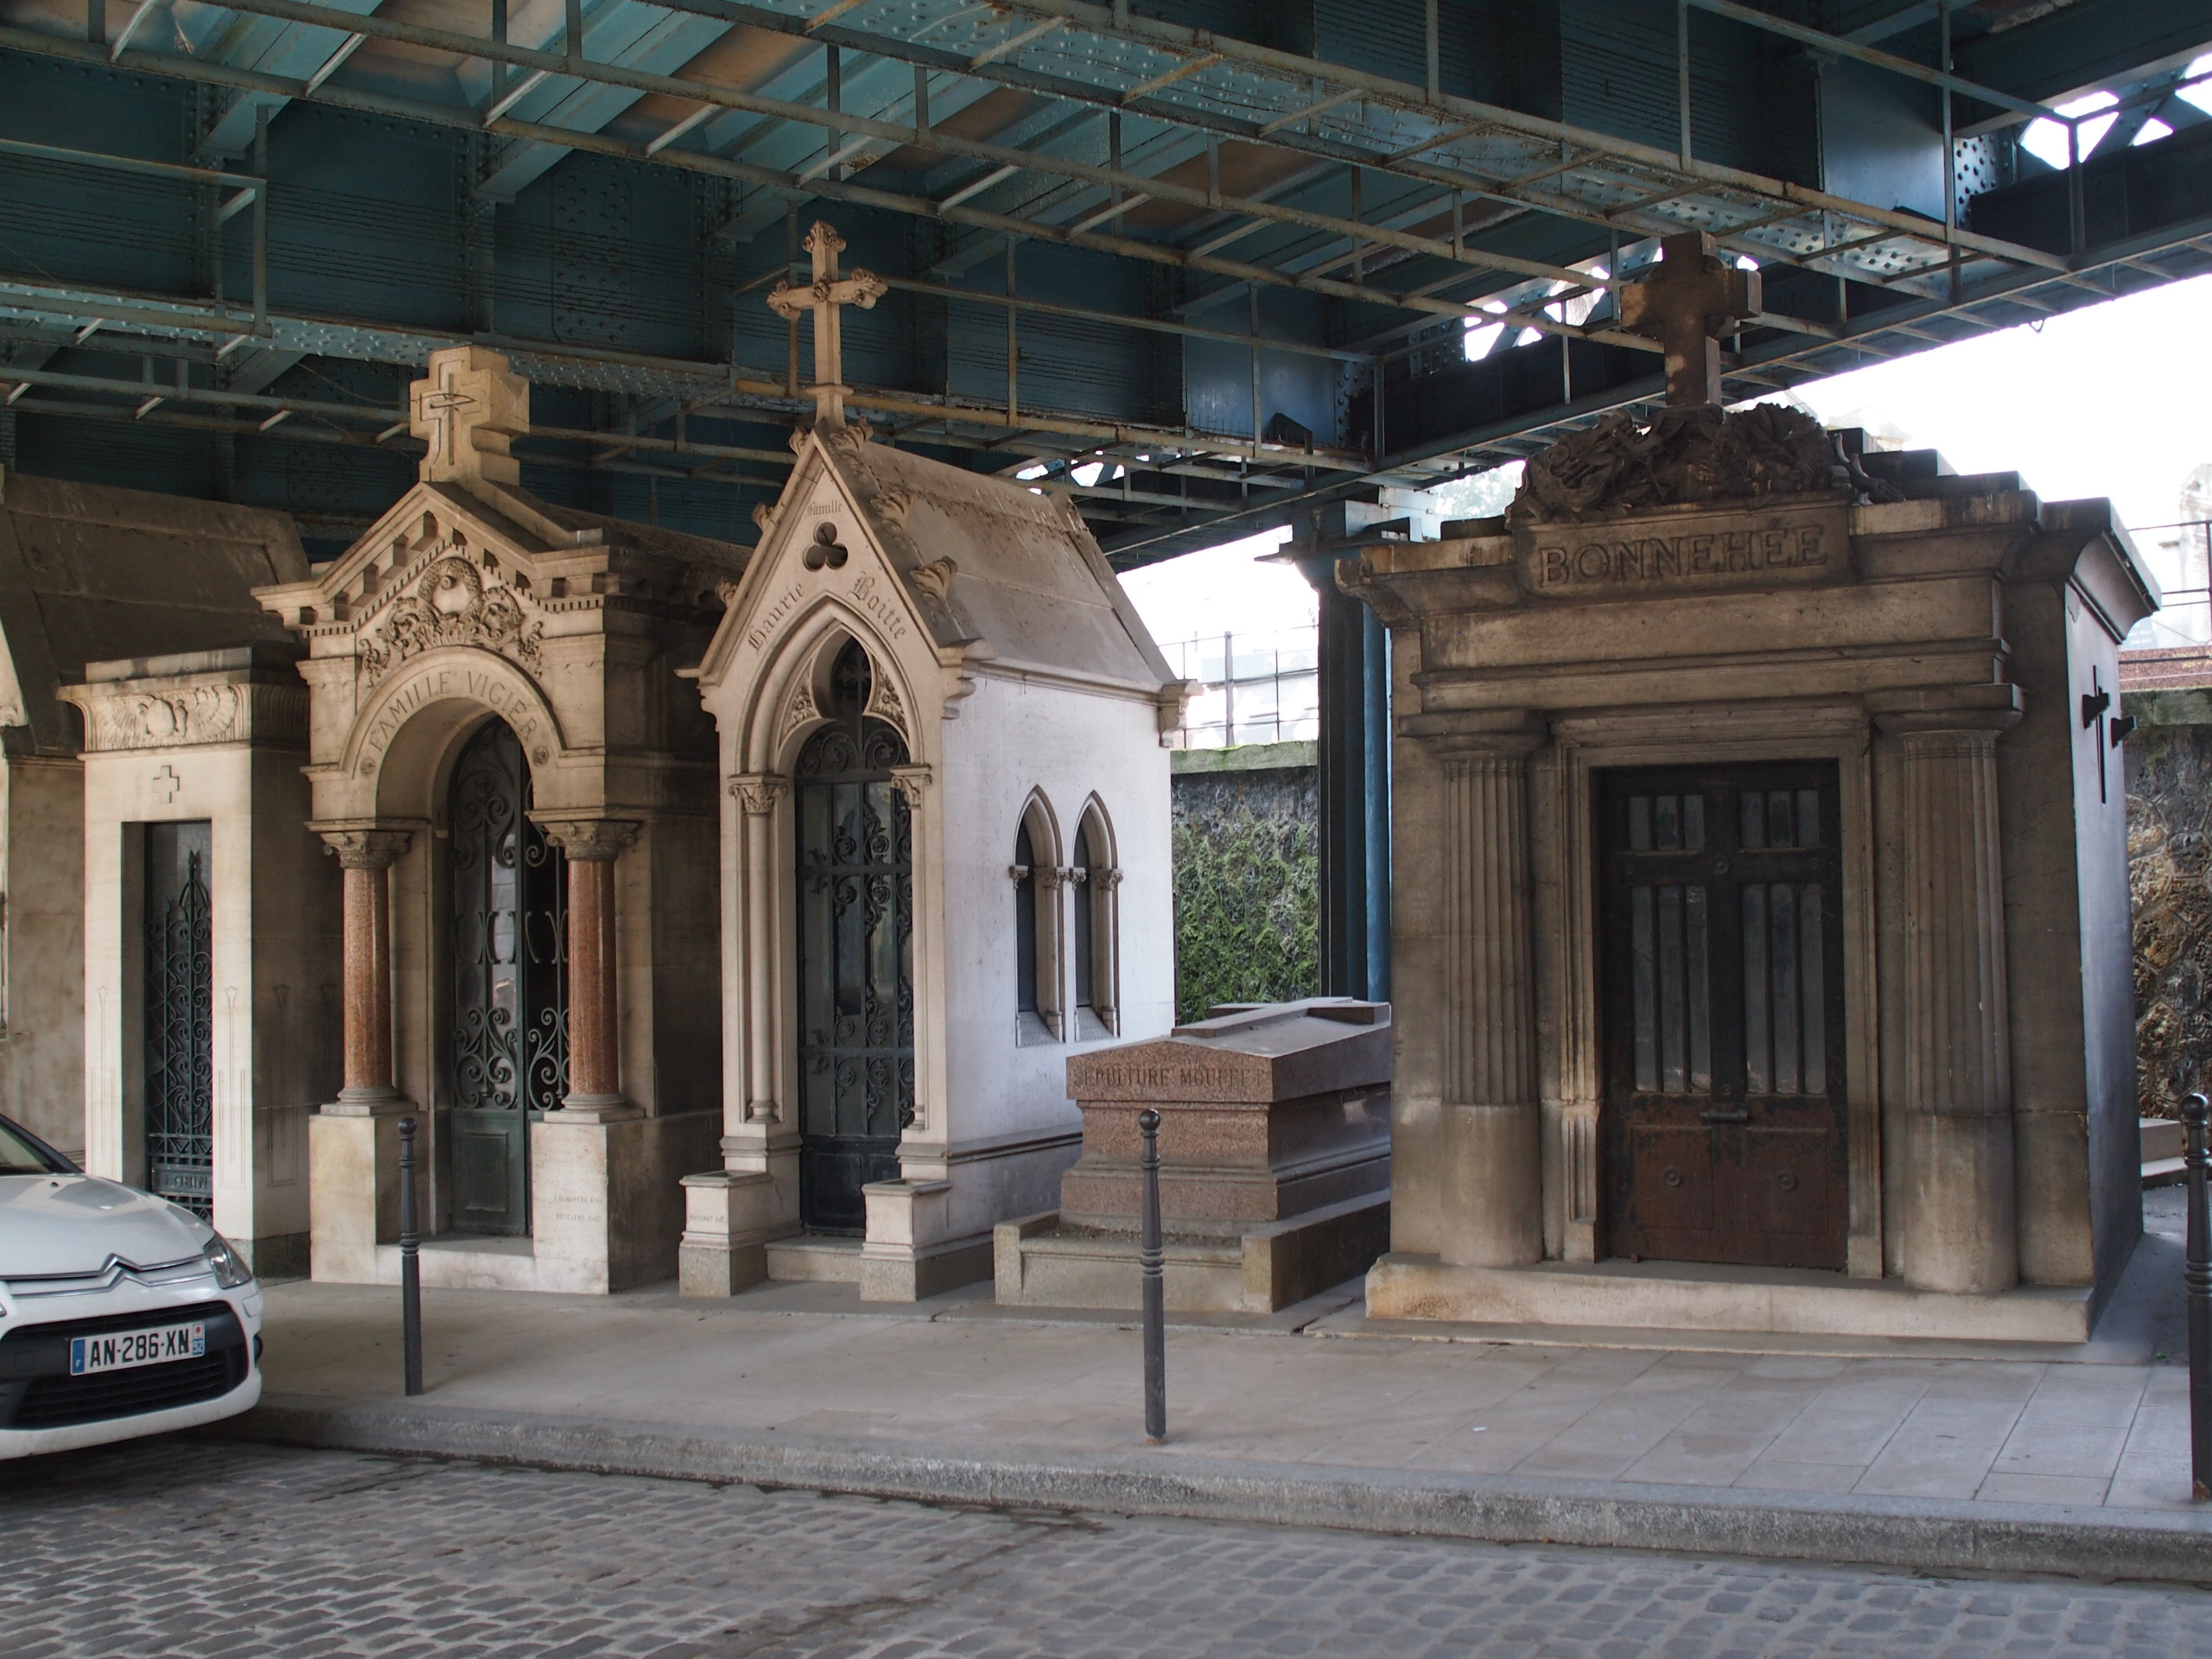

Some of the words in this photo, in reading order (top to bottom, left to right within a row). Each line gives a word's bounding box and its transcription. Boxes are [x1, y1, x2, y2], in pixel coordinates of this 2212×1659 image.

[1539, 518, 1827, 588] BONNEHÉE
[847, 571, 906, 639] Boitte
[370, 671, 452, 752] FAMILLE
[467, 671, 537, 741] VIGIER
[75, 1359, 81, 1368] F
[90, 1328, 189, 1368] AN-286-XN
[193, 1340, 203, 1354] 92
